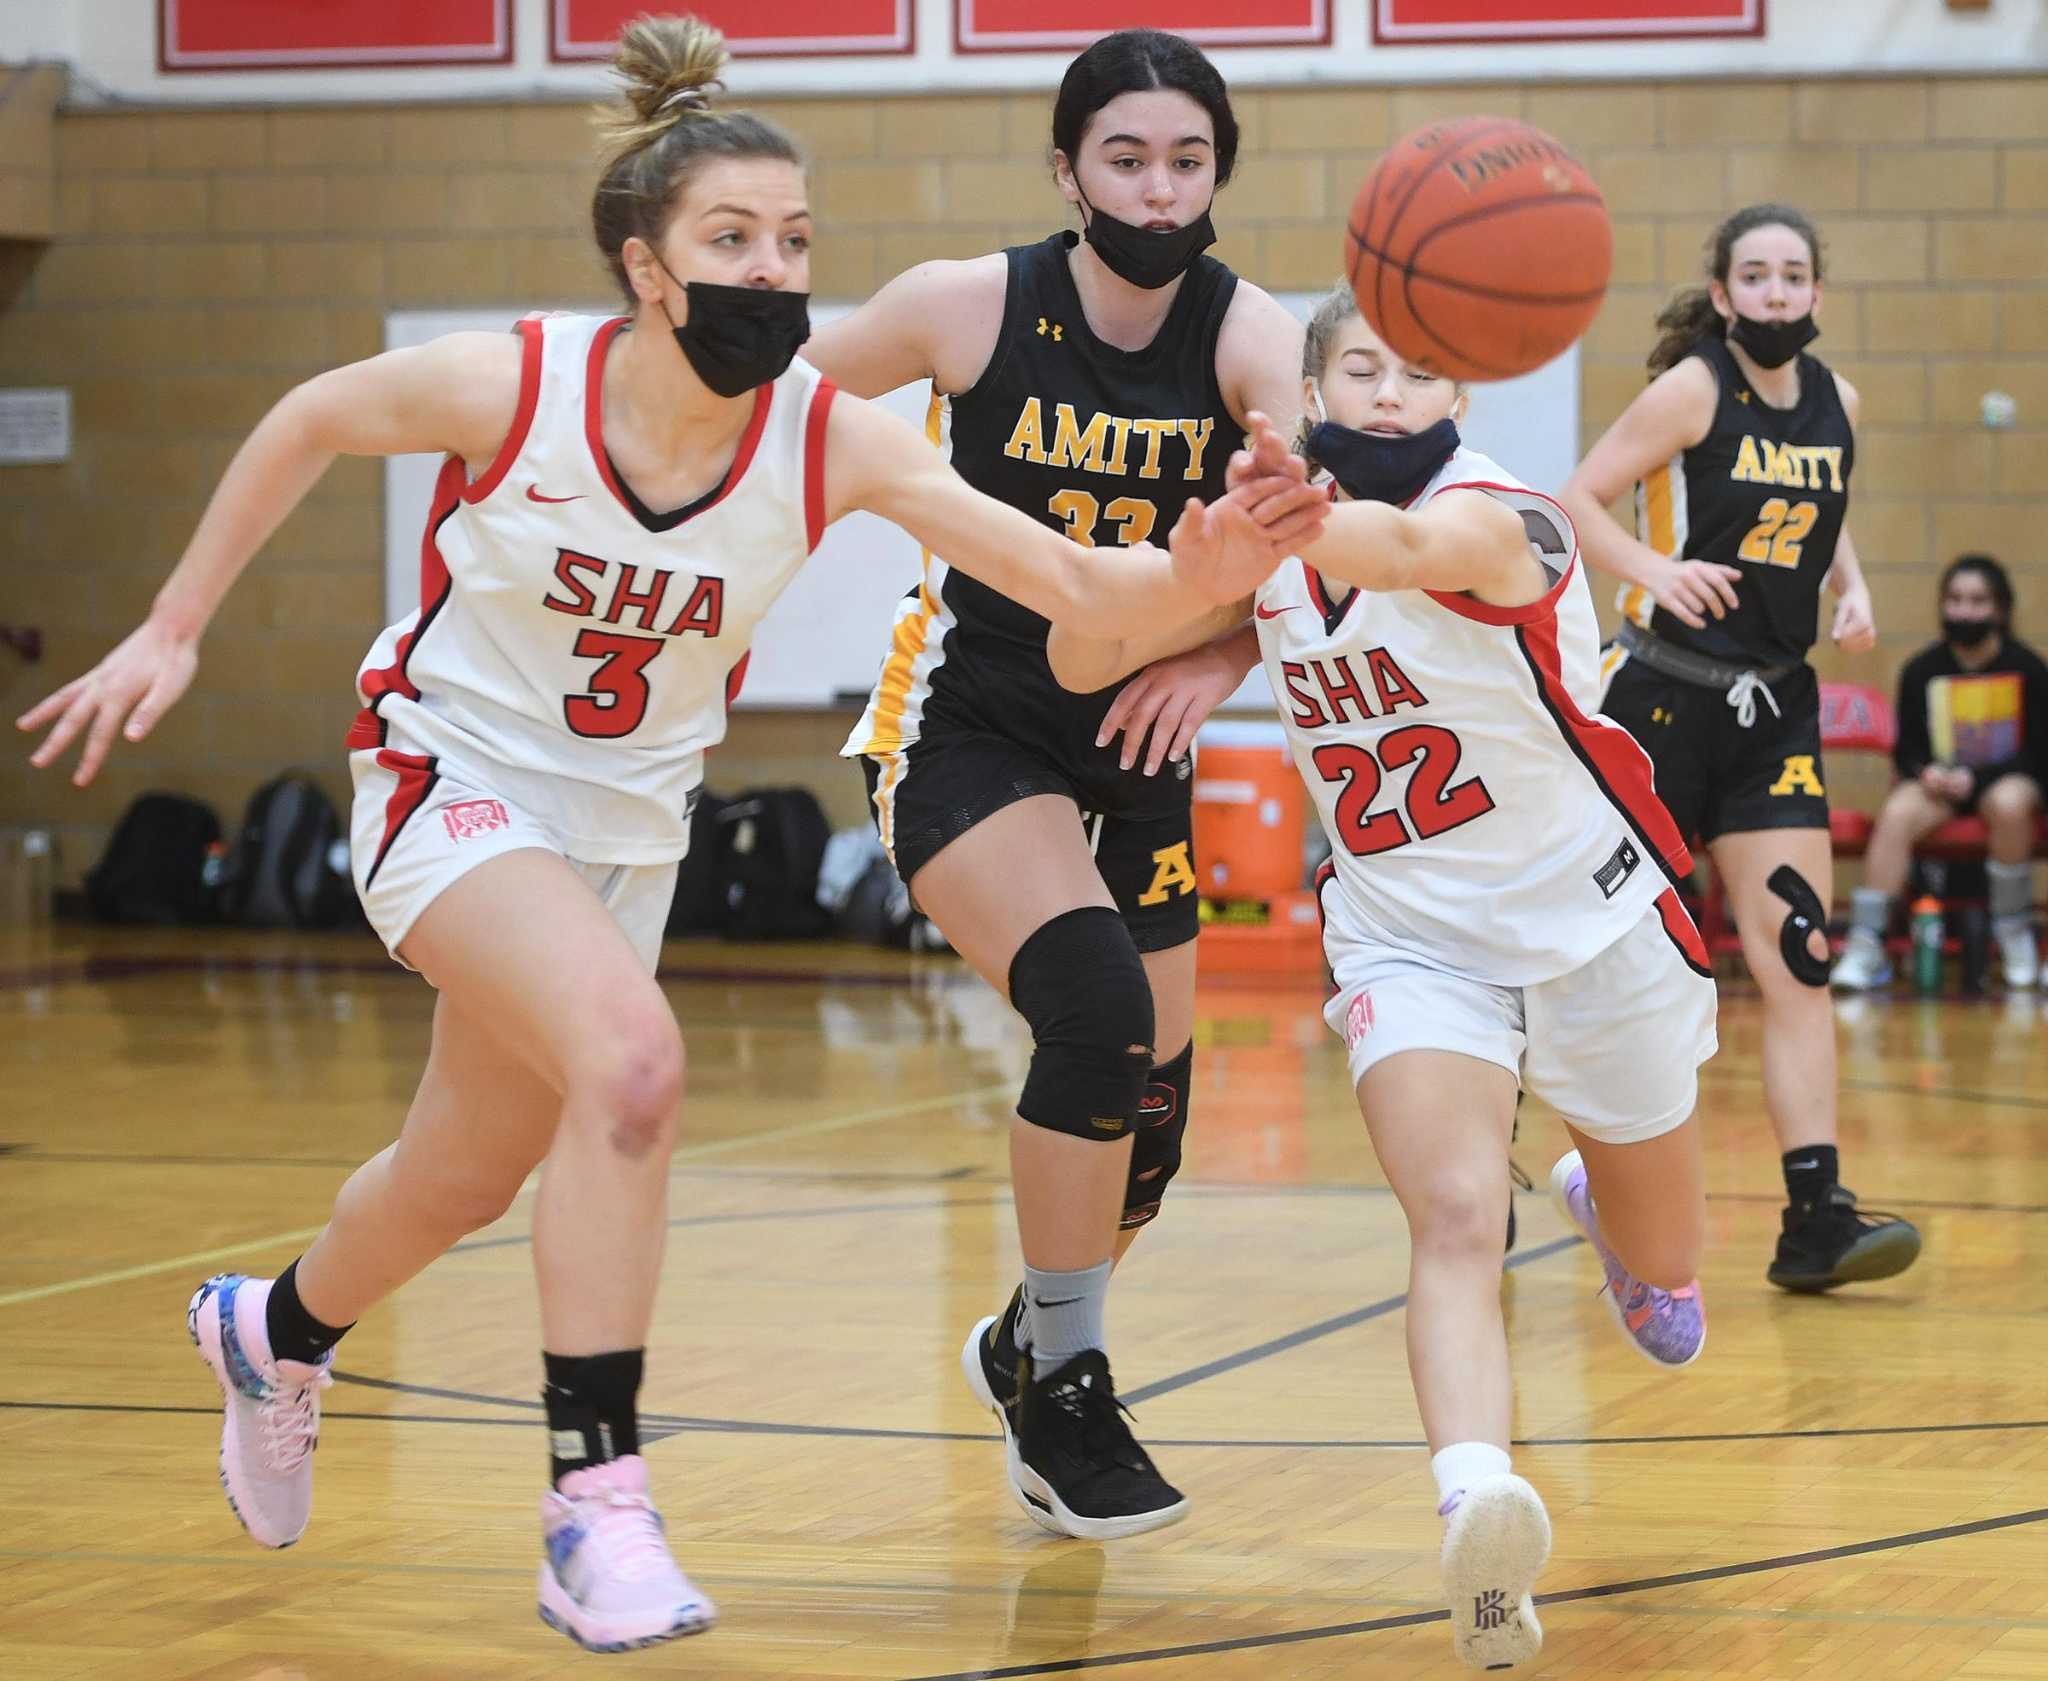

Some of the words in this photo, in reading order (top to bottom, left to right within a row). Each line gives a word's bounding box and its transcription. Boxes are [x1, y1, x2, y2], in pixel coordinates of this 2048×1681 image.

[1003, 396, 1214, 481] AMITY
[1730, 434, 1844, 493] AMITY
[1736, 497, 1819, 570] 22
[542, 546, 724, 638] SHA
[563, 627, 666, 739] 3
[1281, 646, 1429, 728] SHA
[1312, 724, 1496, 857] 22
[1769, 755, 1824, 796] A
[1138, 840, 1196, 906] A
